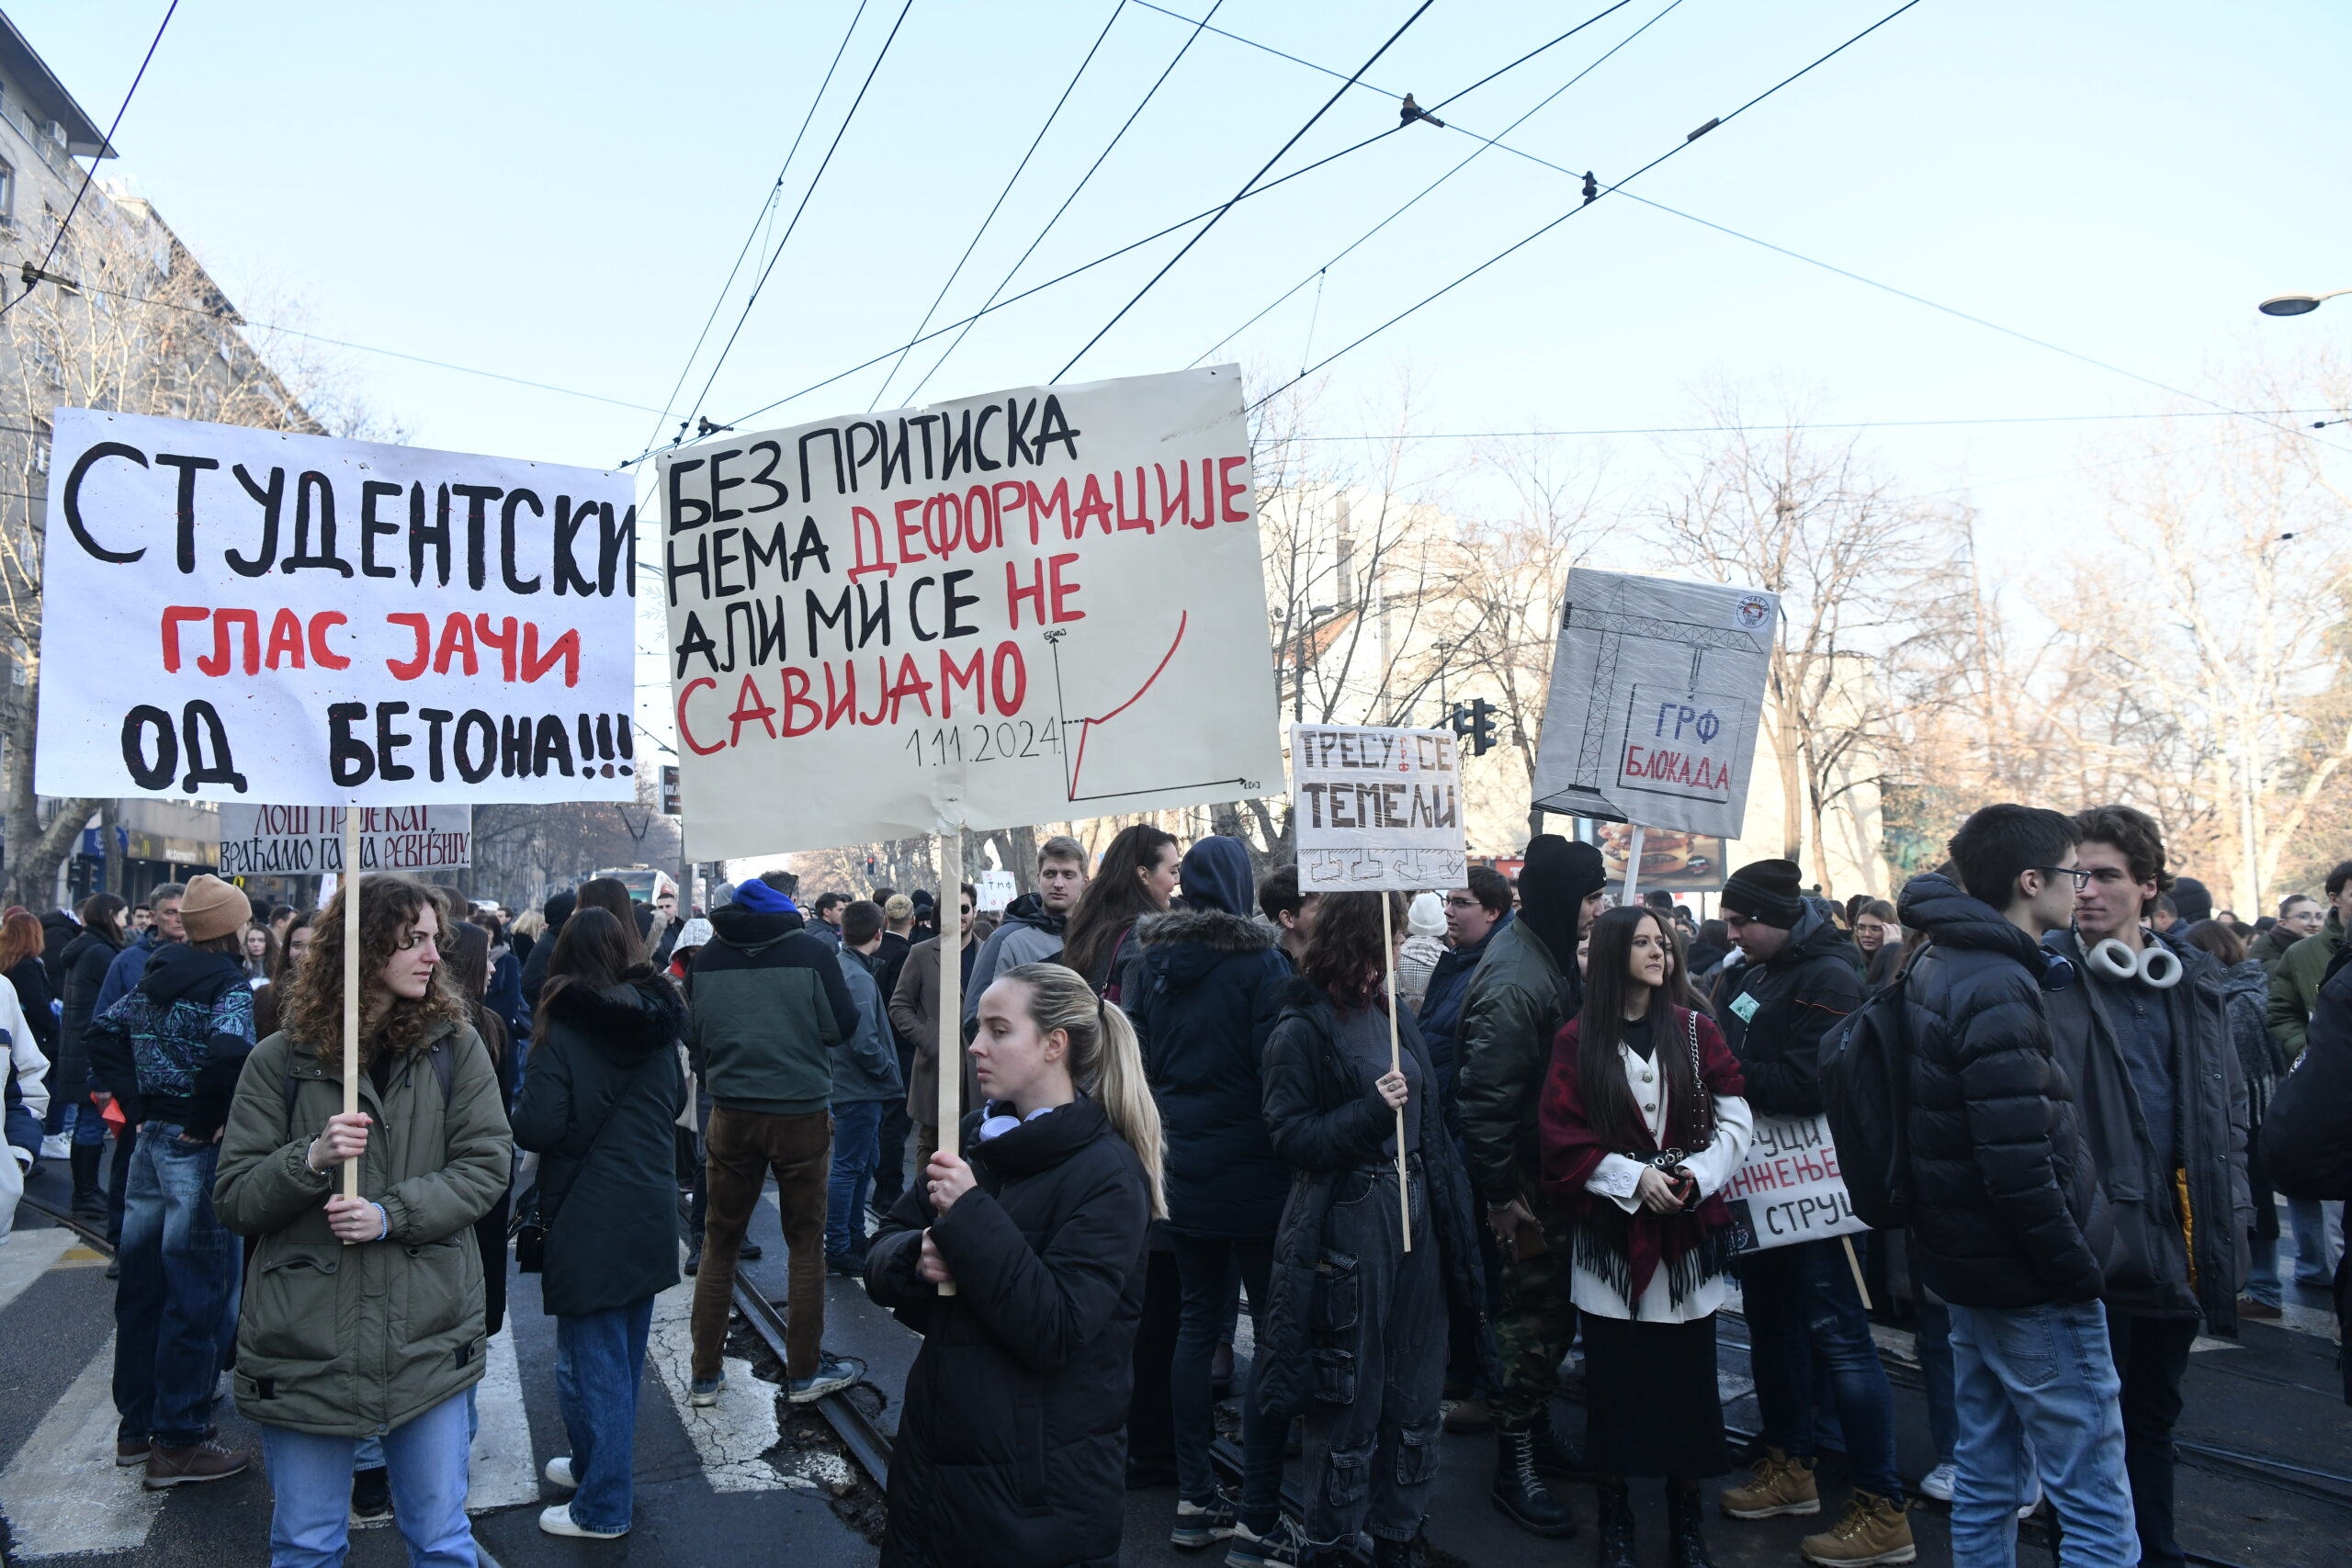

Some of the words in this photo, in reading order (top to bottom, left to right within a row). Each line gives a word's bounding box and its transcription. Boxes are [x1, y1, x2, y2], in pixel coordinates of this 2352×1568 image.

[669, 440, 790, 536] БЕЗ
[798, 394, 1081, 502] ПРИТИСКА
[62, 441, 636, 598] СТУДЕНТСКИ
[667, 515, 831, 607] НЕМА
[848, 456, 1250, 585] ДЕФОРМАЦИЈЕ
[161, 605, 352, 678] ГЛАС
[386, 611, 582, 688] ЈАЧИ
[676, 595, 786, 679] АЛИ
[806, 580, 891, 659] МИ
[909, 570, 981, 641] СЕ
[1006, 552, 1087, 631] НЕ
[677, 640, 1027, 756] САВИЈАМО
[1655, 702, 1720, 745] ГРФ
[120, 699, 249, 795] ОД
[328, 701, 635, 788] БЕТОНА!!!
[1299, 731, 1395, 769] ТРЕСУ
[1416, 735, 1453, 771] СЕ
[1625, 745, 1729, 791] БЛОКАДА
[220, 837, 313, 874] ВРАЋАМО
[321, 837, 343, 869] ГА
[254, 804, 309, 835] ЛОШ
[1745, 1118, 1823, 1161] УЦИ
